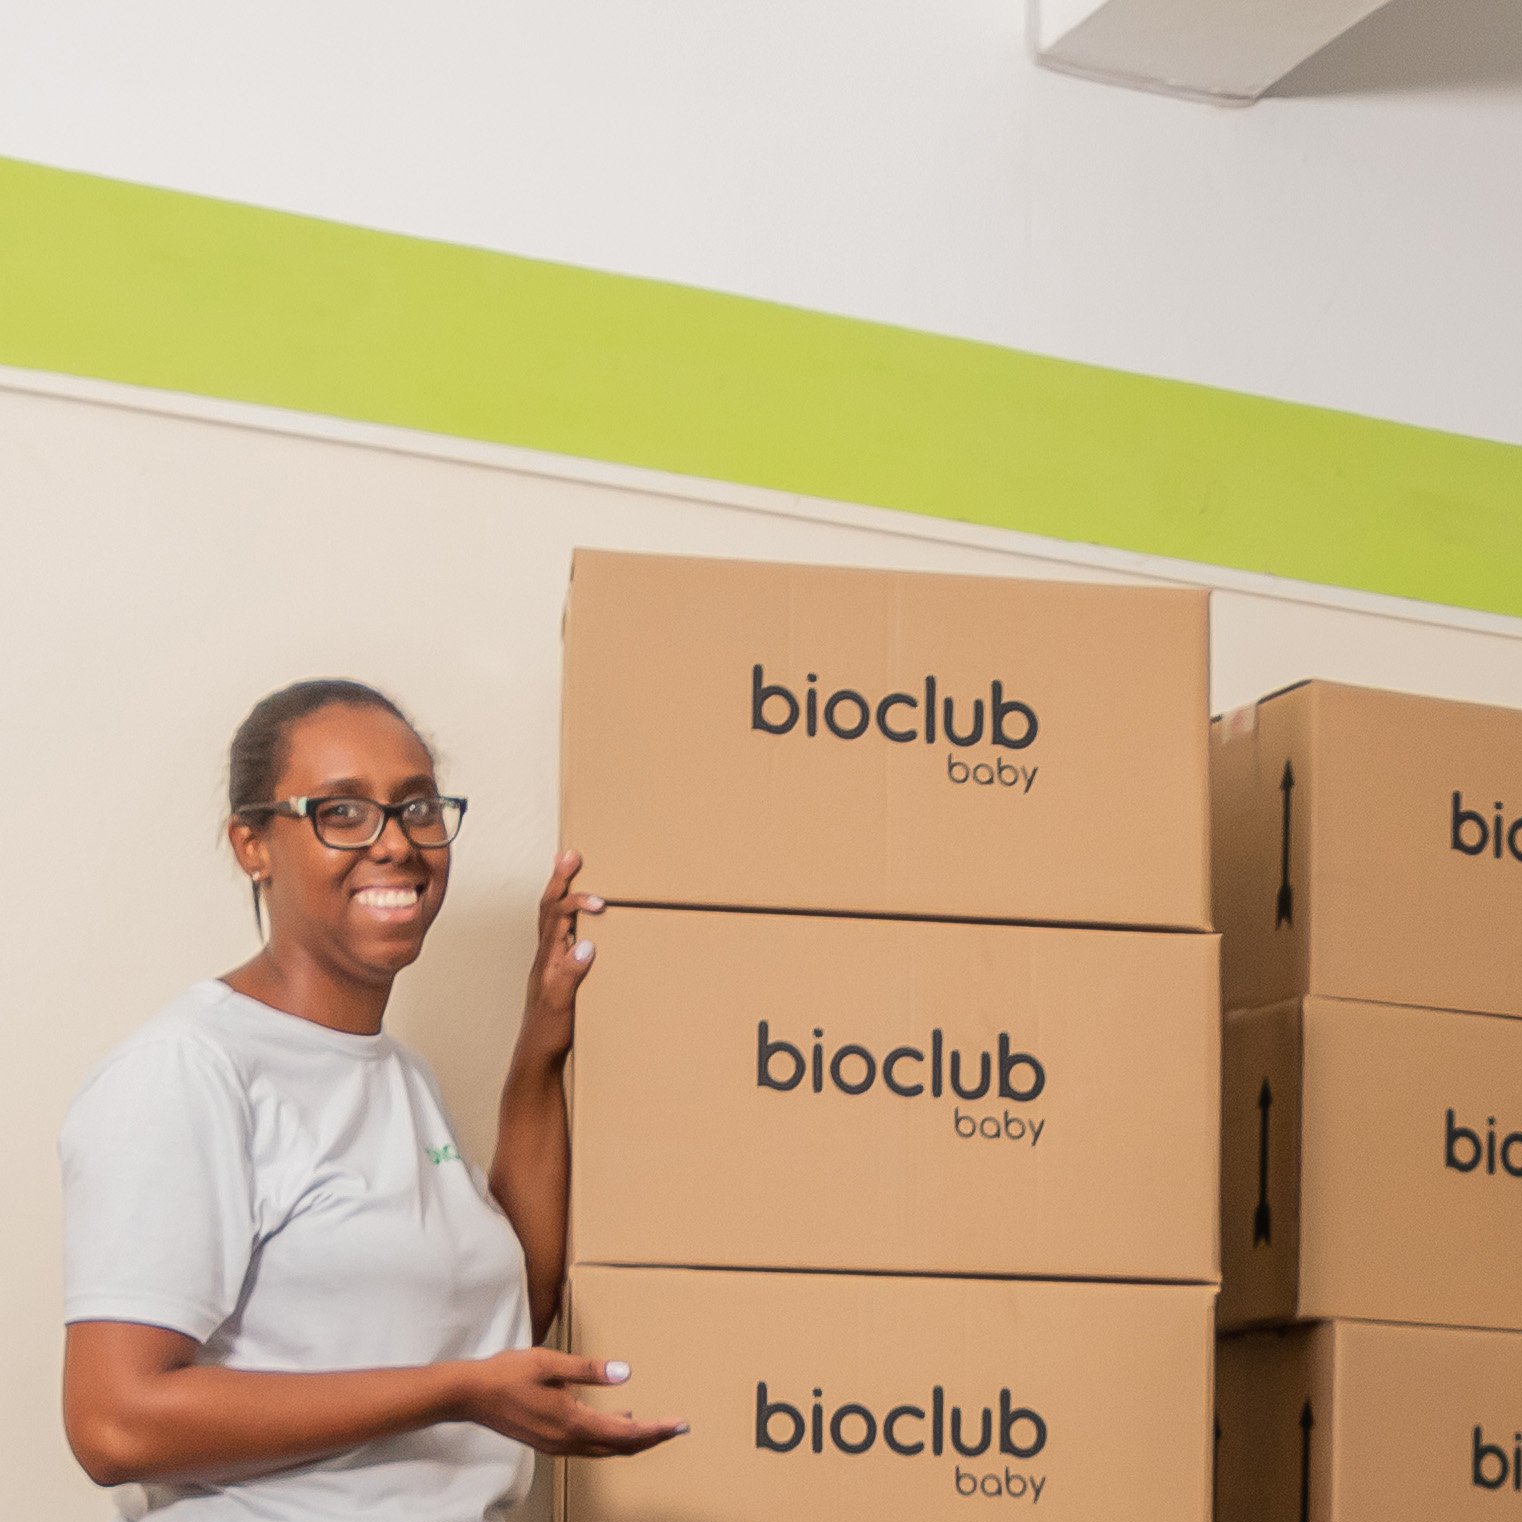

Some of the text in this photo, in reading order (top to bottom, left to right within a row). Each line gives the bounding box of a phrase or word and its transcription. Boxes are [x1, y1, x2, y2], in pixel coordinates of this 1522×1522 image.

[751, 663, 1039, 750] bioclub
[947, 753, 1039, 794] baby
[756, 1019, 1046, 1103] bioclub
[954, 1107, 1045, 1147] baby
[755, 1381, 1048, 1460] bioclub
[955, 1466, 1046, 1505] baby
